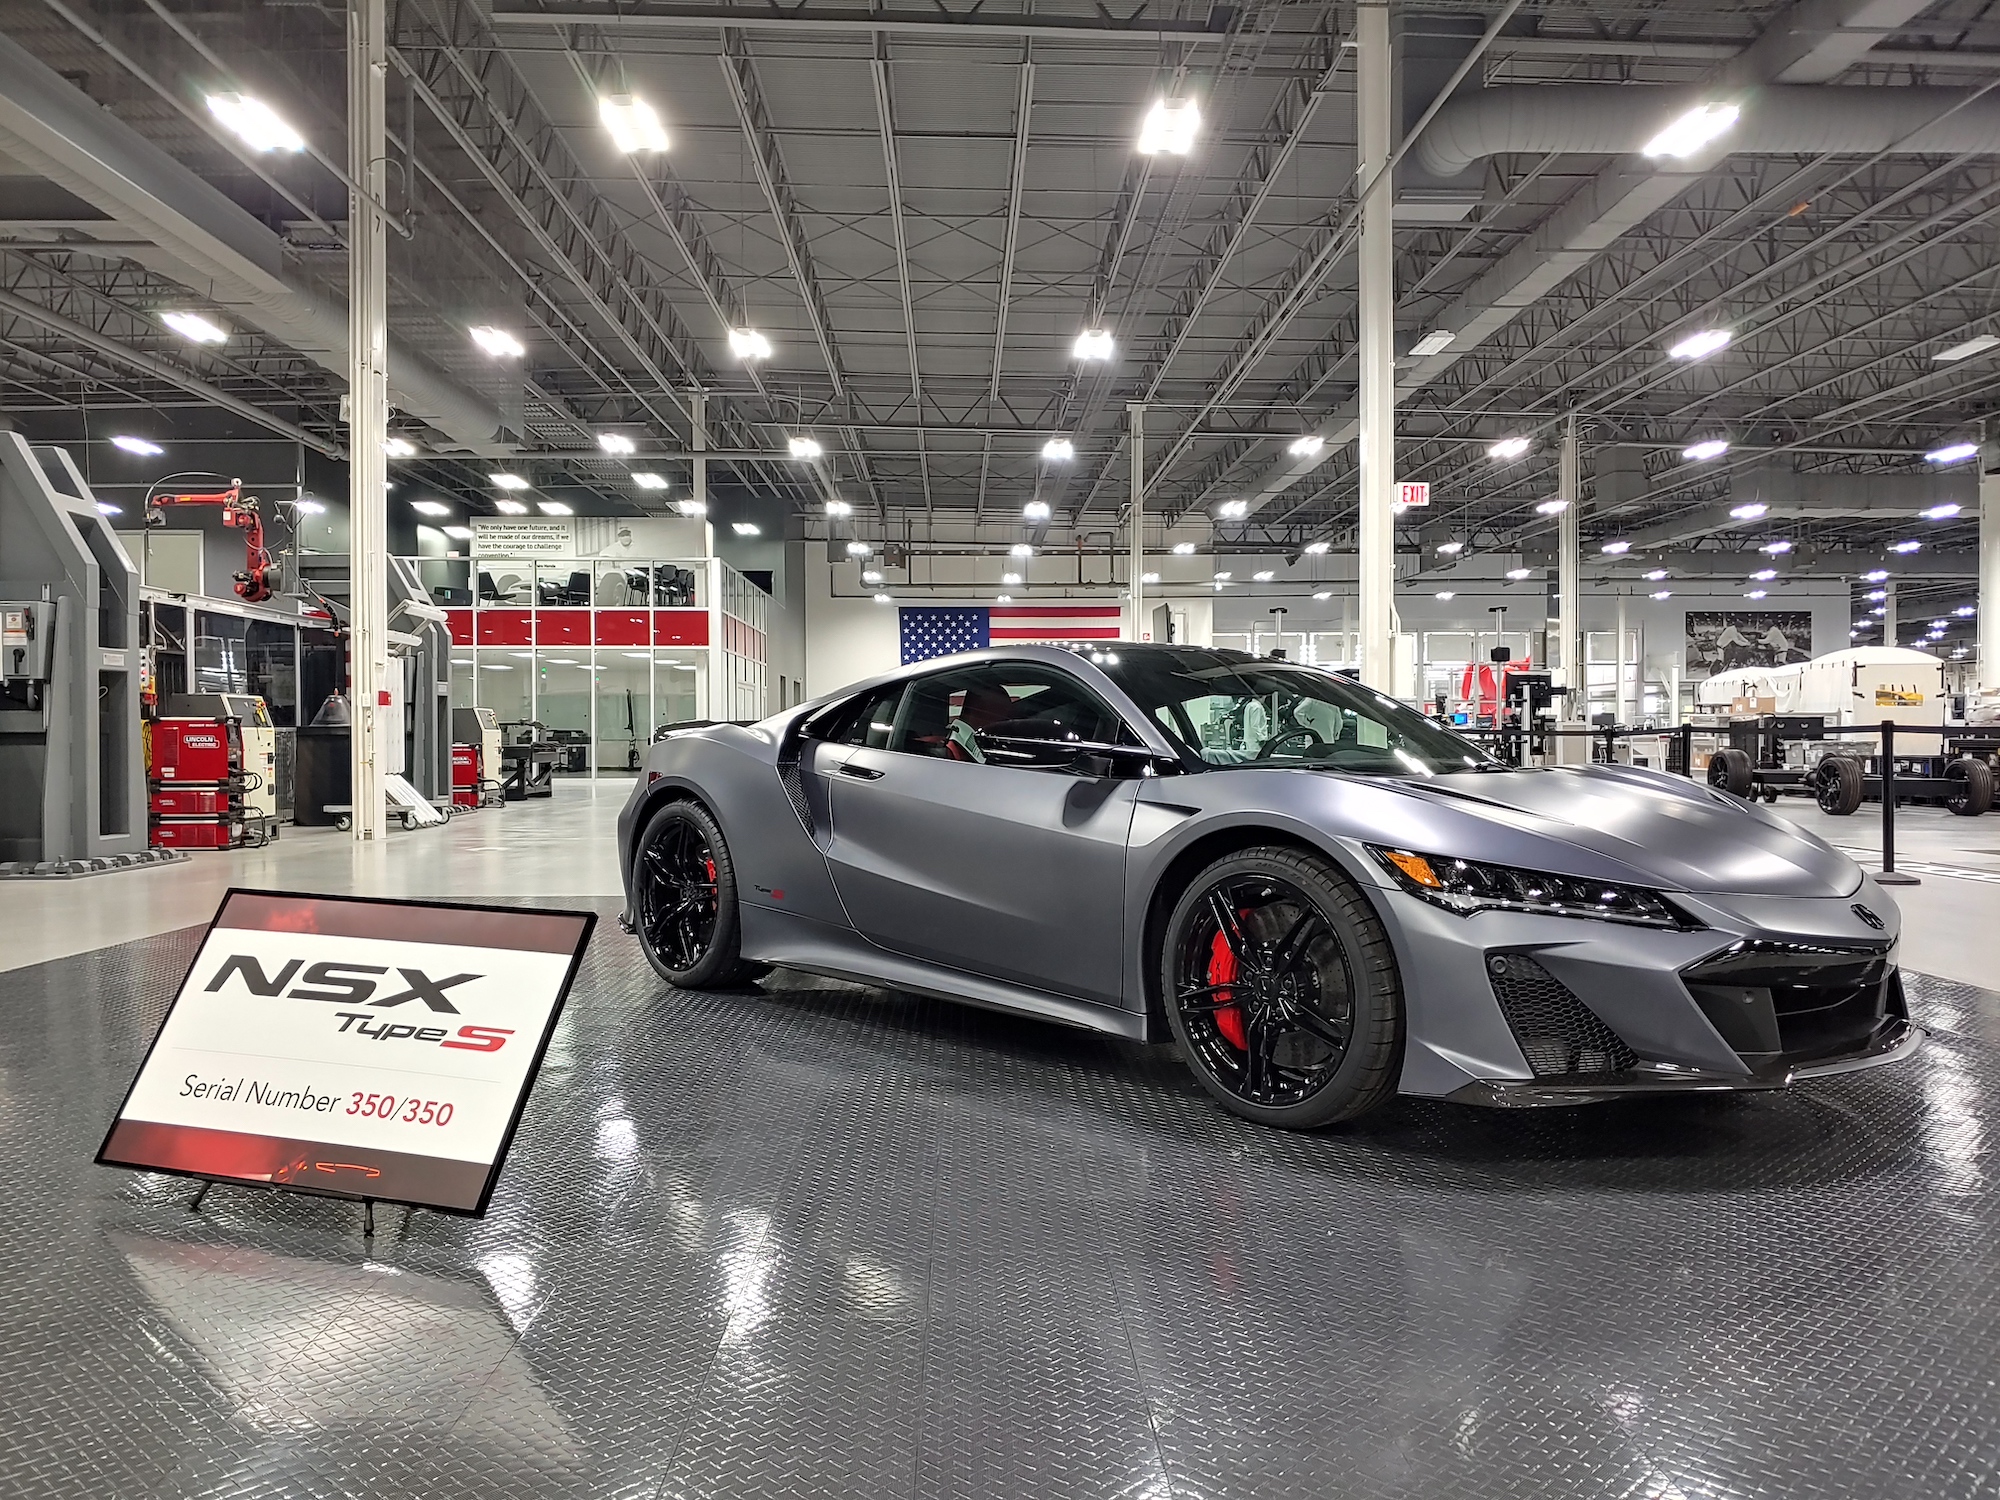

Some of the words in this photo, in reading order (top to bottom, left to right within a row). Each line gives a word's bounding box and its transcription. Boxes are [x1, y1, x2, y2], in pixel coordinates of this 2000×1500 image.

[1403, 485, 1425, 503] EXIT
[203, 954, 488, 1015] NSX
[178, 1073, 245, 1104] Serial
[245, 1081, 342, 1114] Number
[344, 1091, 454, 1127] 350/350
